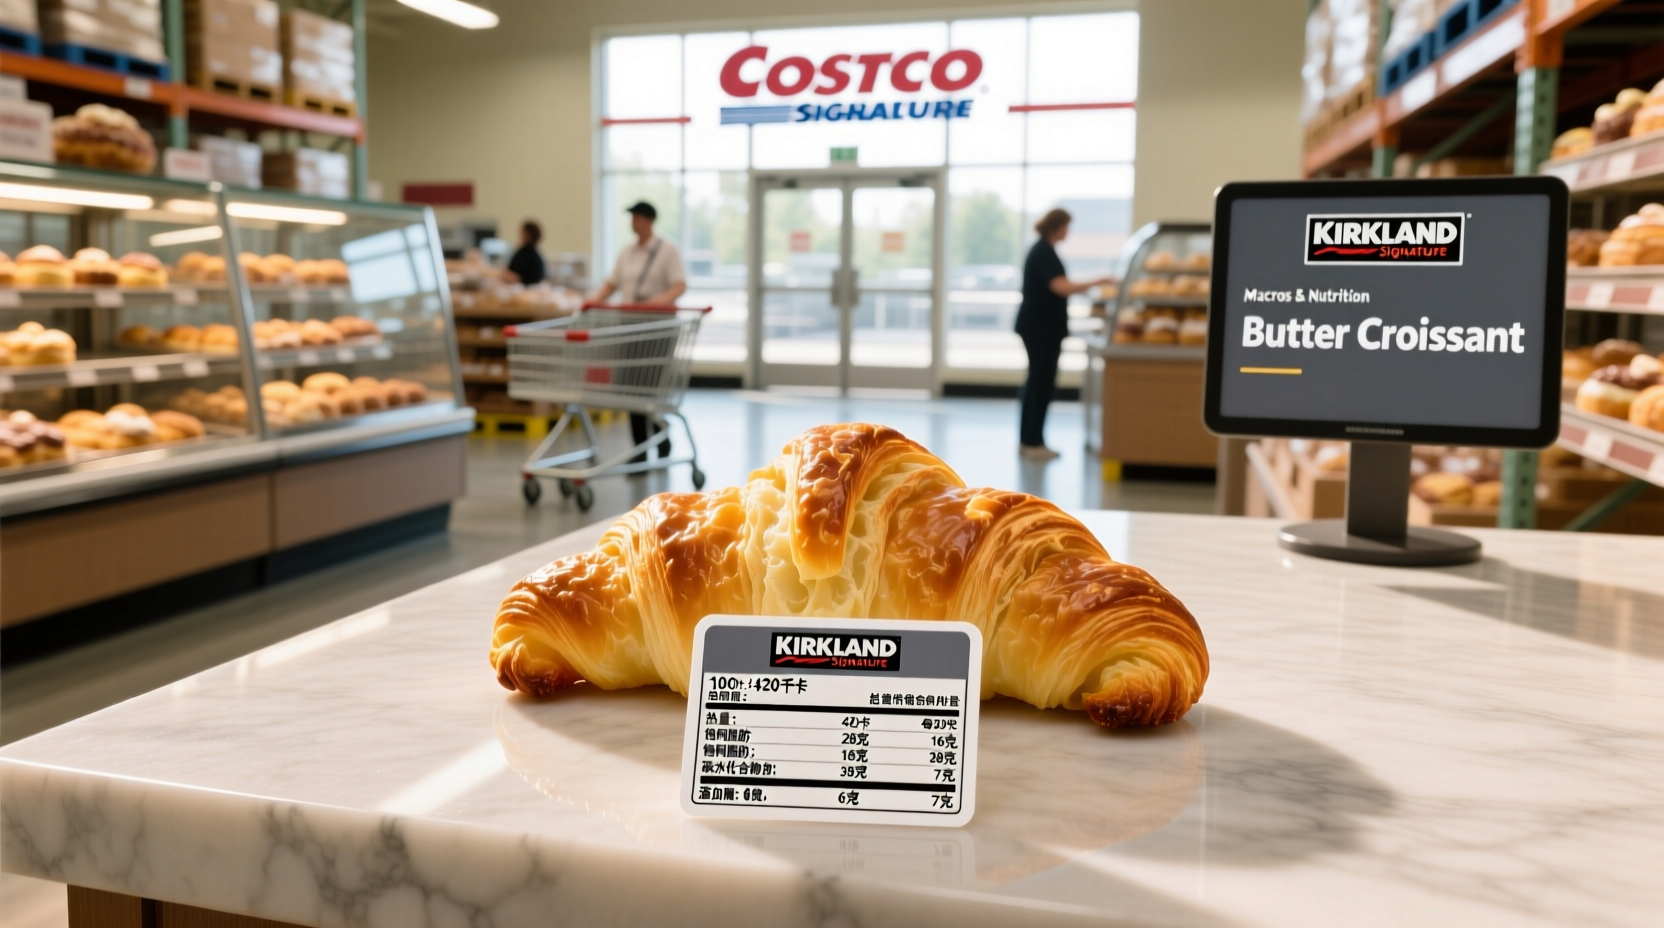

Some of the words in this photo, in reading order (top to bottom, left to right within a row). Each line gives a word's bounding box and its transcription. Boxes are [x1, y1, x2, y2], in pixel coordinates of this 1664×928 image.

[720, 46, 983, 97] COSTCO
[1313, 221, 1458, 245] KIRKLAND
[1244, 288, 1292, 303] Macros
[1295, 288, 1305, 303] &
[1308, 288, 1370, 303] Nutrition
[1242, 315, 1351, 349] Butter
[1357, 316, 1525, 353] Croissant
[775, 636, 897, 657] KIRKLAND
